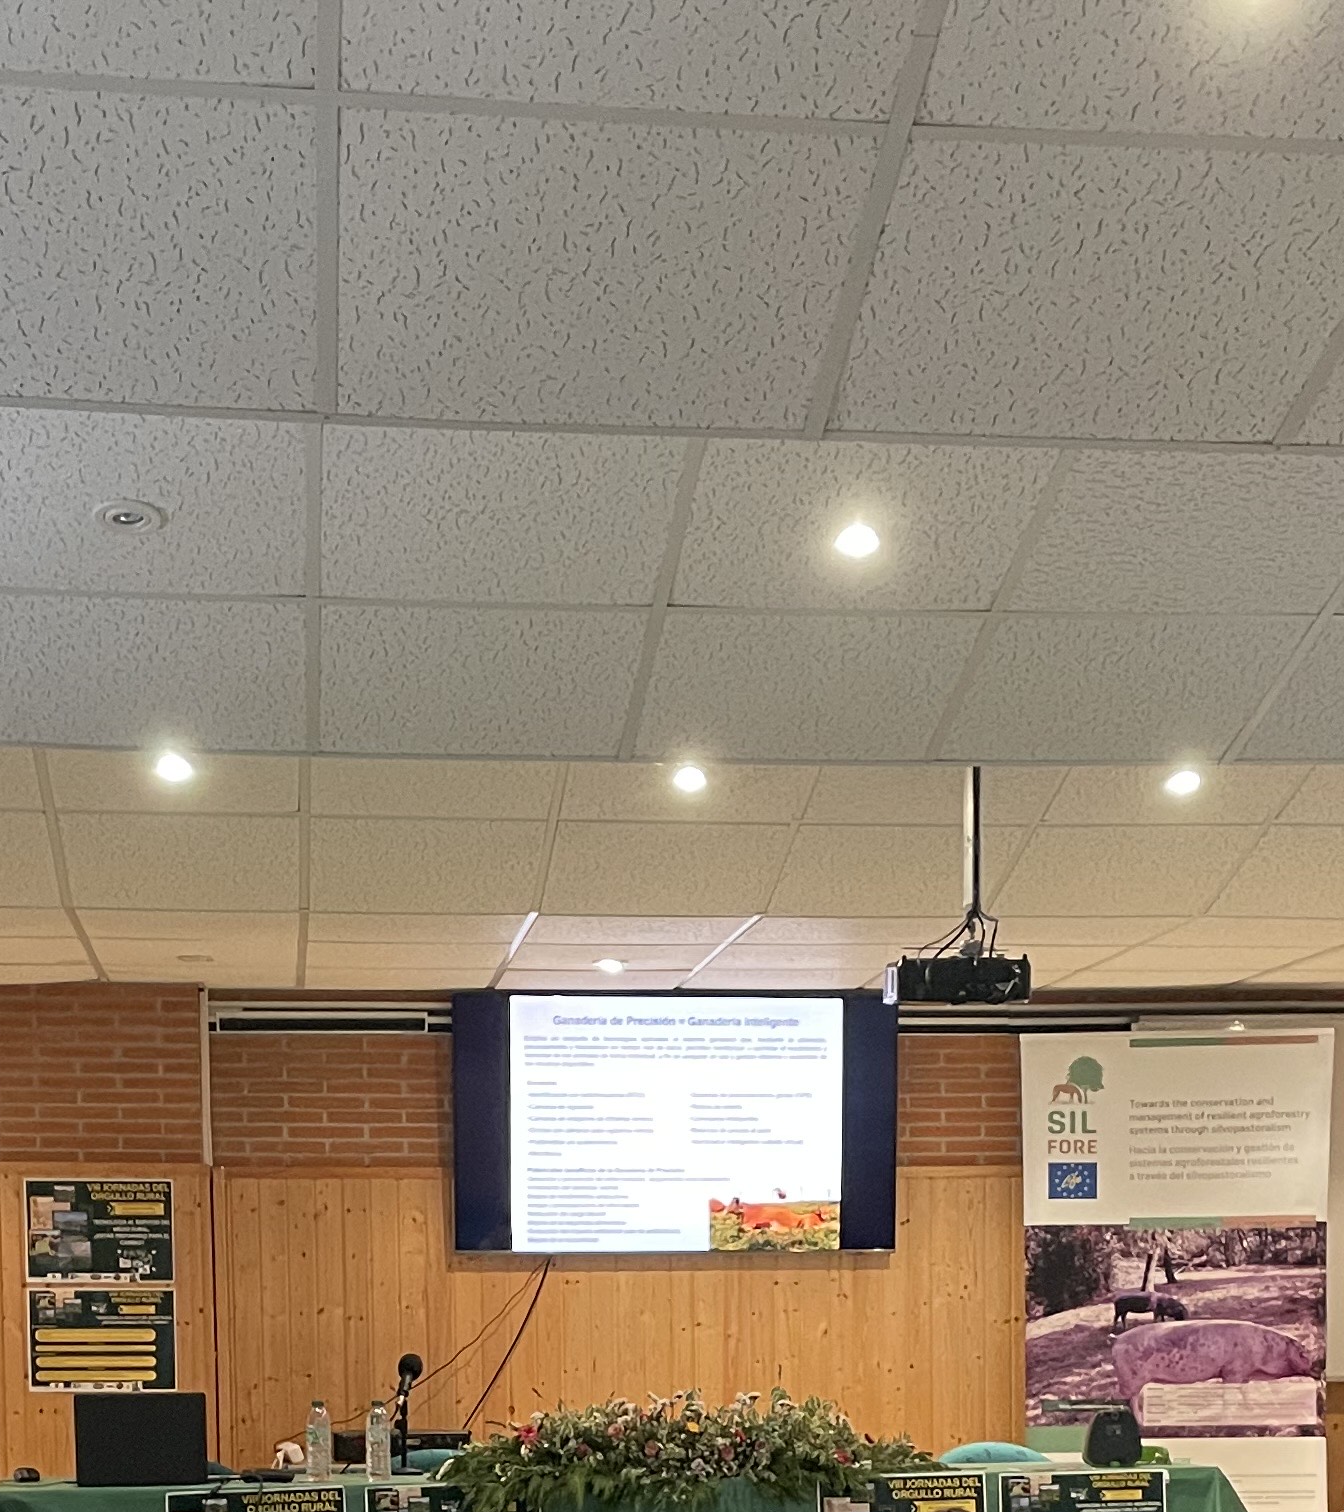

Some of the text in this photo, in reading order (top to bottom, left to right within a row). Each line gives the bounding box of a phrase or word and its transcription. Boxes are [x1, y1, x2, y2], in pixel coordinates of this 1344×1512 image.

[1172, 1098, 1188, 1108] the
[1047, 1110, 1097, 1134] SIL
[1194, 1111, 1205, 1121] of
[1171, 1125, 1209, 1135] through
[1047, 1138, 1098, 1155] FORE
[905, 1477, 960, 1489] JORNADAS
[961, 1476, 982, 1487] DEL
[261, 1491, 319, 1504] JORNADAS
[320, 1490, 342, 1501] DEL
[892, 1487, 978, 1500] ORGULLO RURAL
[301, 1501, 338, 1512] RURAL
